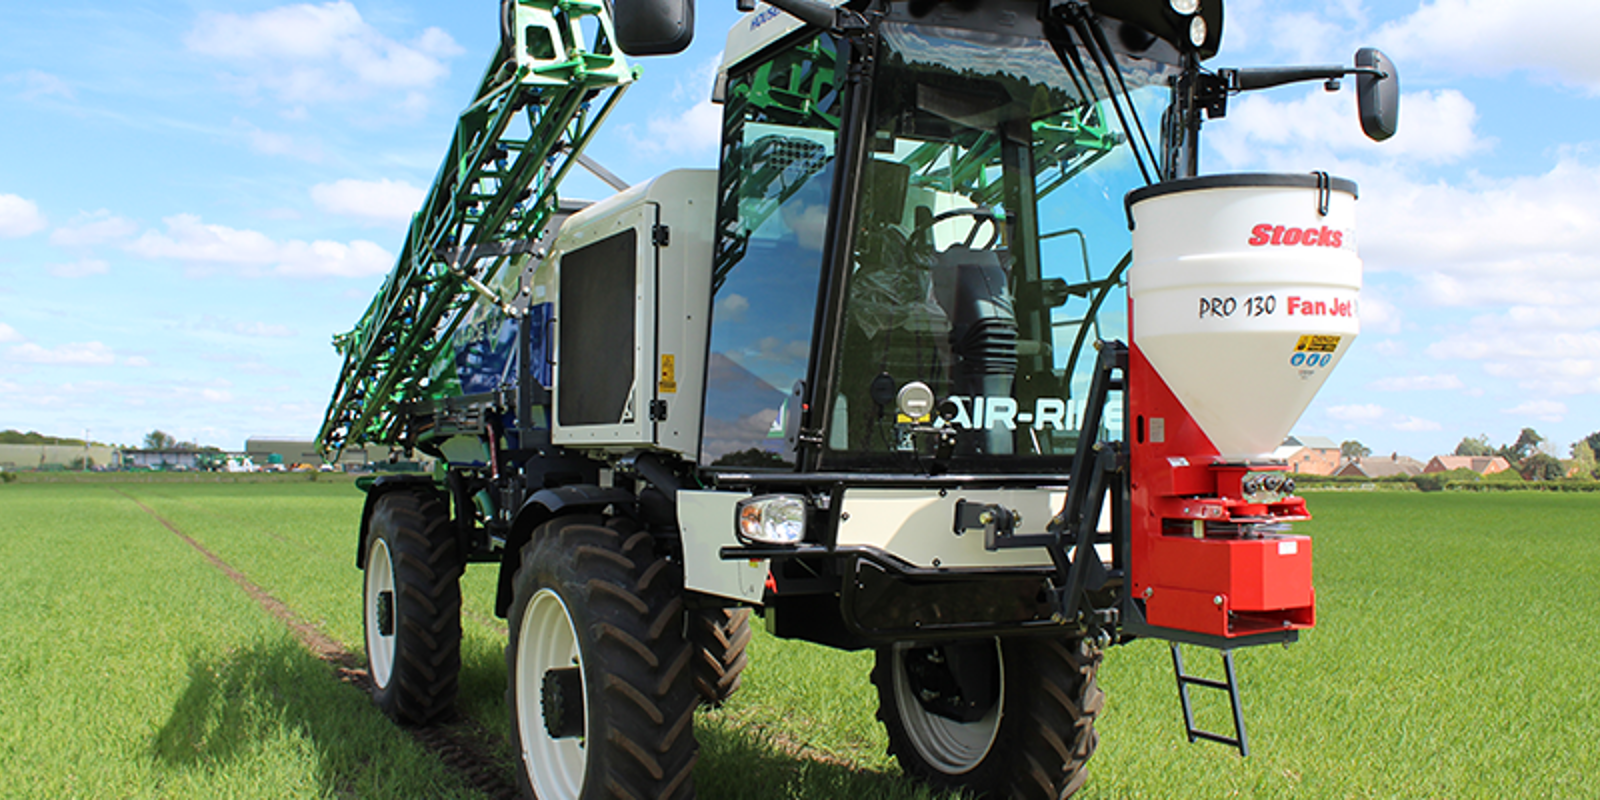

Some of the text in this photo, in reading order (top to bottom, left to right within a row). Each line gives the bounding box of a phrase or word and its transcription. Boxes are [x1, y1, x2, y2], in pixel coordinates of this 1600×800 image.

[1248, 223, 1343, 249] Stocks
[1199, 297, 1237, 319] PRO
[1244, 294, 1277, 317] 130
[1287, 296, 1326, 316] Fan
[1329, 297, 1352, 317] Jet
